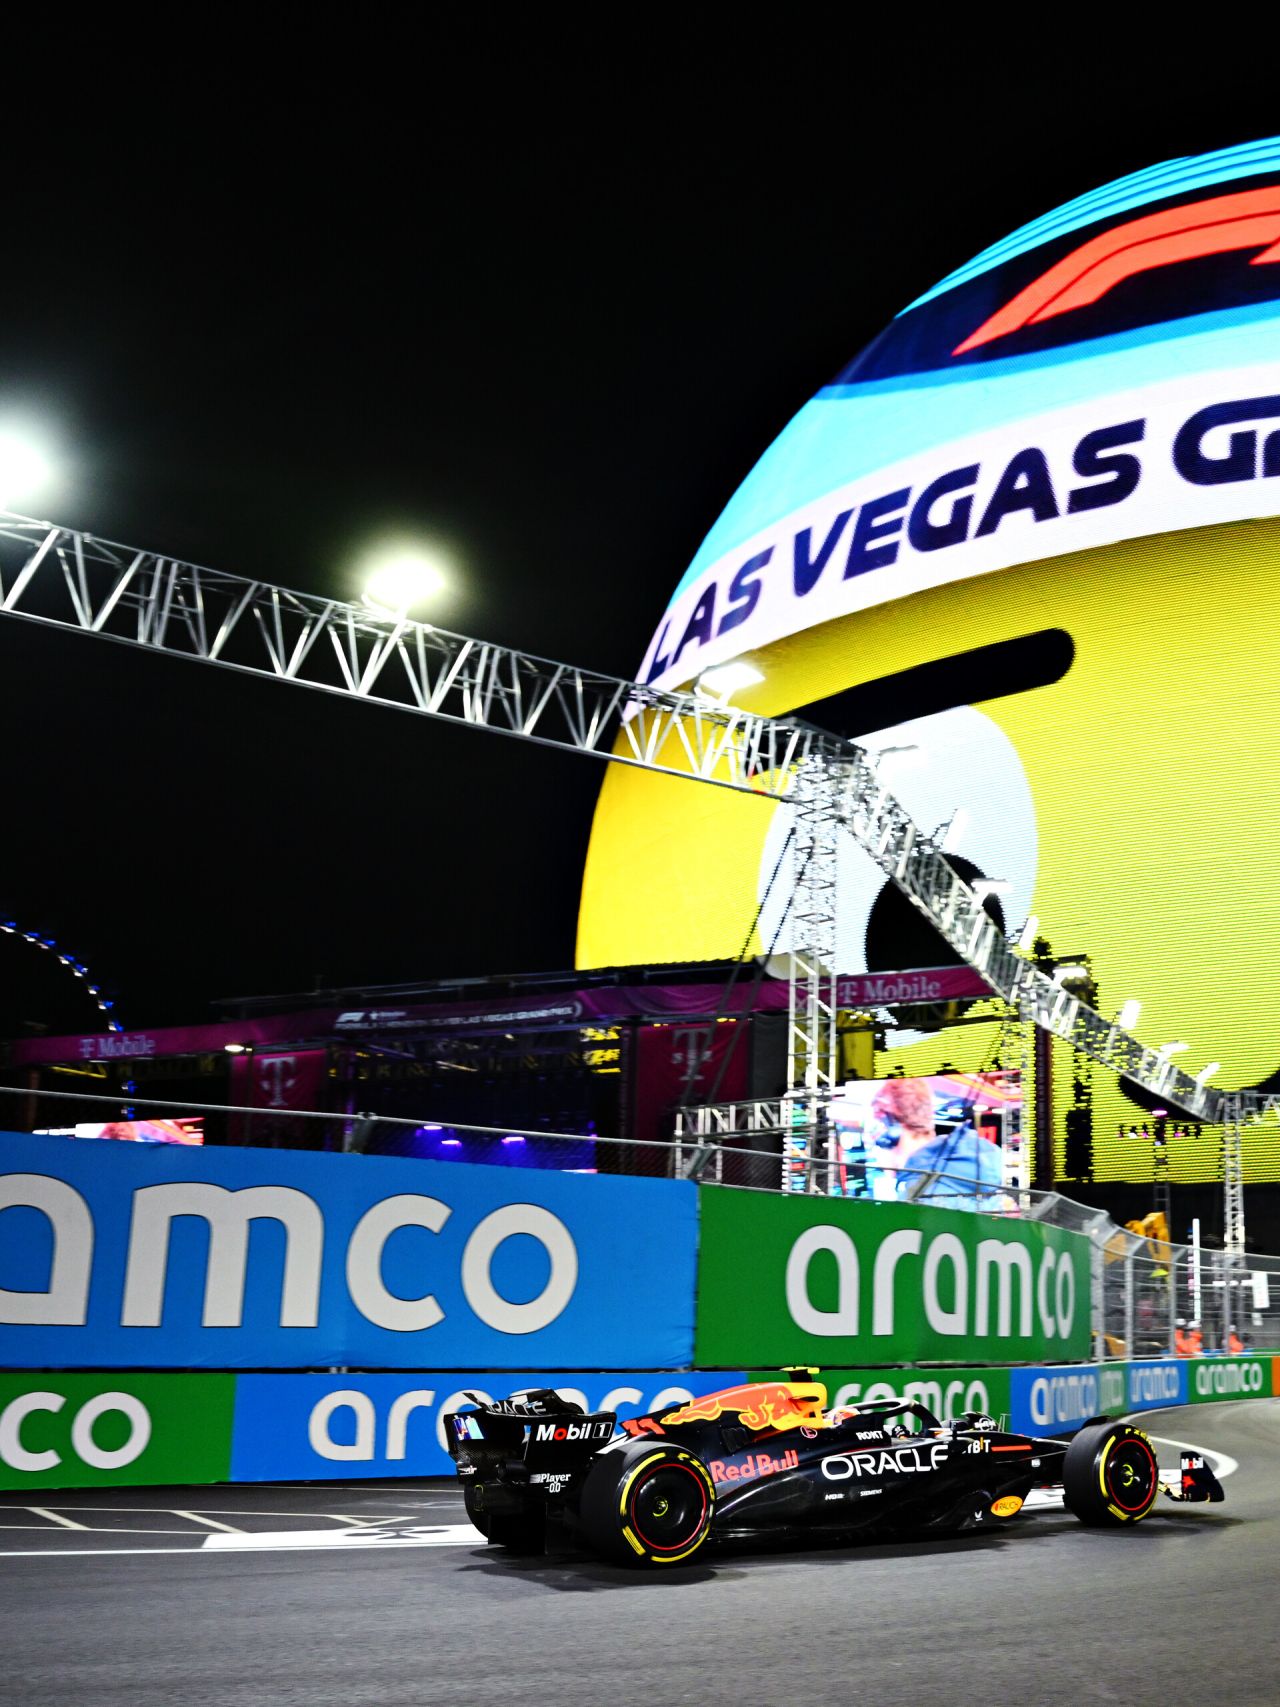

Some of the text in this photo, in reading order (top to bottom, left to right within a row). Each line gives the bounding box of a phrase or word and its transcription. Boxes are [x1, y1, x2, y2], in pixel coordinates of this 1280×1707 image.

[647, 547, 773, 684] LAS
[793, 418, 1147, 597] VEGAS
[863, 977, 940, 1001] Mobile
[98, 1035, 156, 1056] Mobile
[785, 1225, 1075, 1340] aramco
[1196, 1362, 1263, 1396] aramco
[535, 1423, 592, 1442] Mobil
[710, 1449, 799, 1483] Red Bull
[820, 1444, 949, 1481] ORACLE
